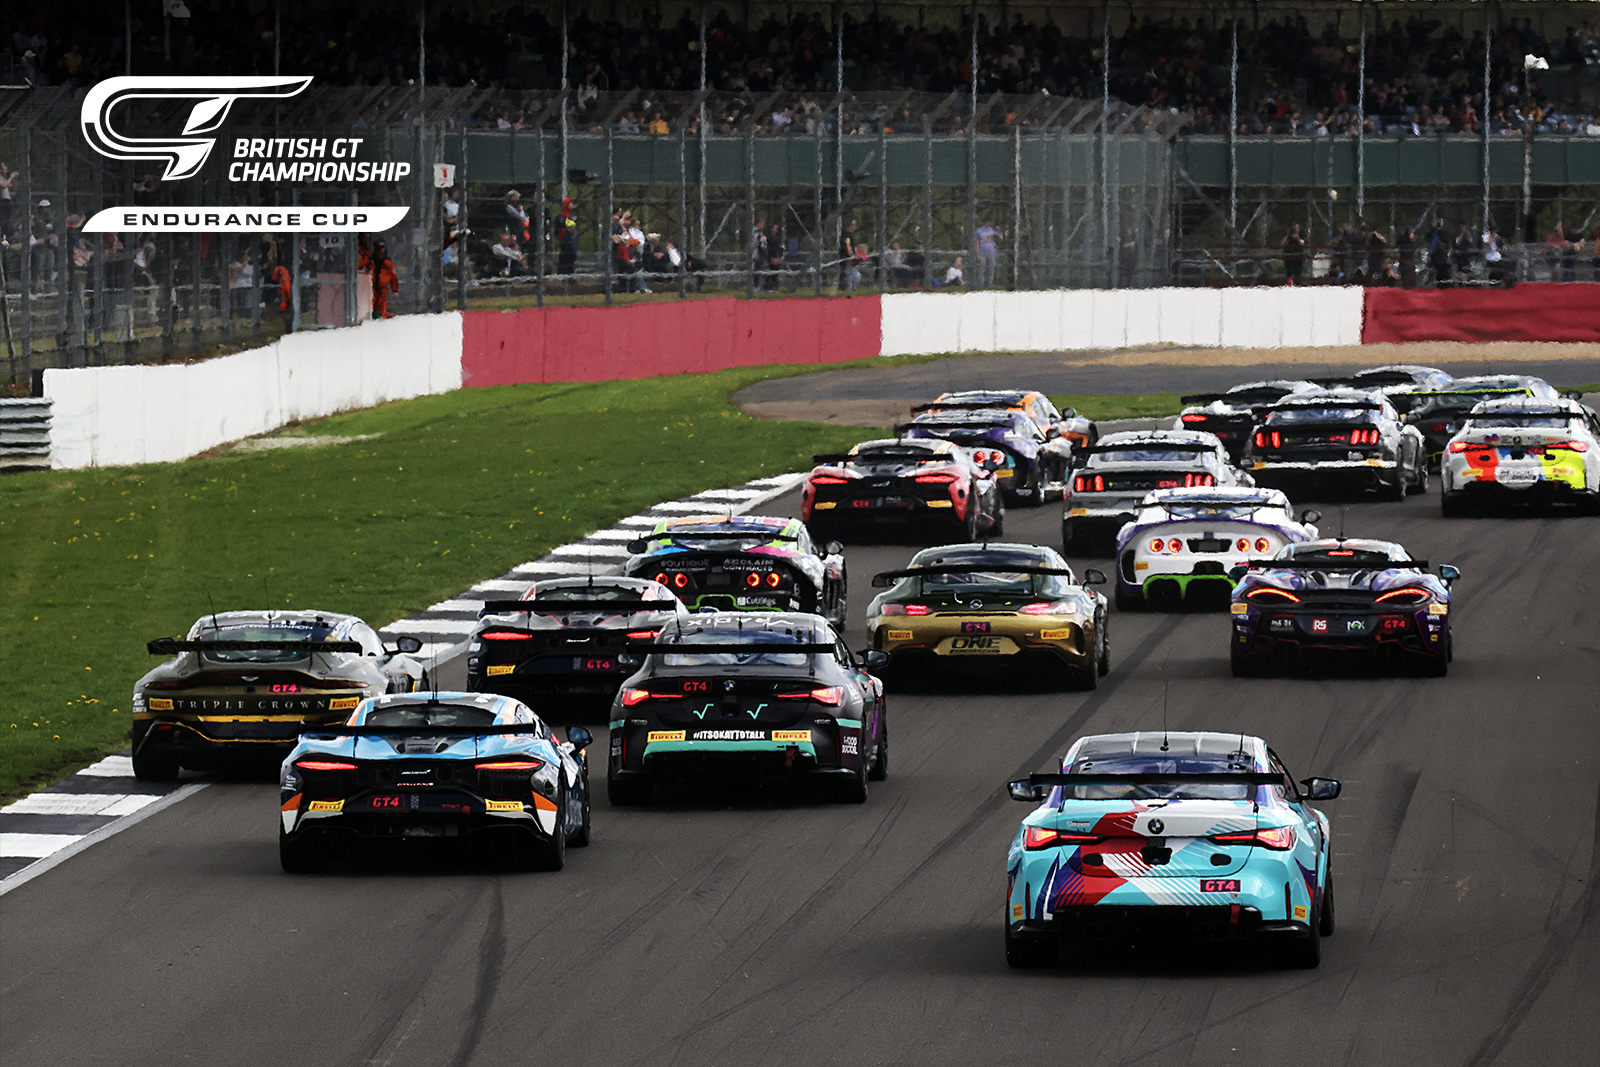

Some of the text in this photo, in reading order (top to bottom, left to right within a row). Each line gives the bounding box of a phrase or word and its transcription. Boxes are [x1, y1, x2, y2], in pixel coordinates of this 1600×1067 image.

[1384, 620, 1406, 629] GT4
[951, 637, 1001, 649] ONE
[587, 660, 610, 669] GT4
[272, 684, 298, 693] GT4
[683, 682, 708, 691] GT4
[177, 701, 325, 709] TRIPLE CROWN
[372, 797, 400, 808] GT4
[1205, 880, 1236, 891] GT4
